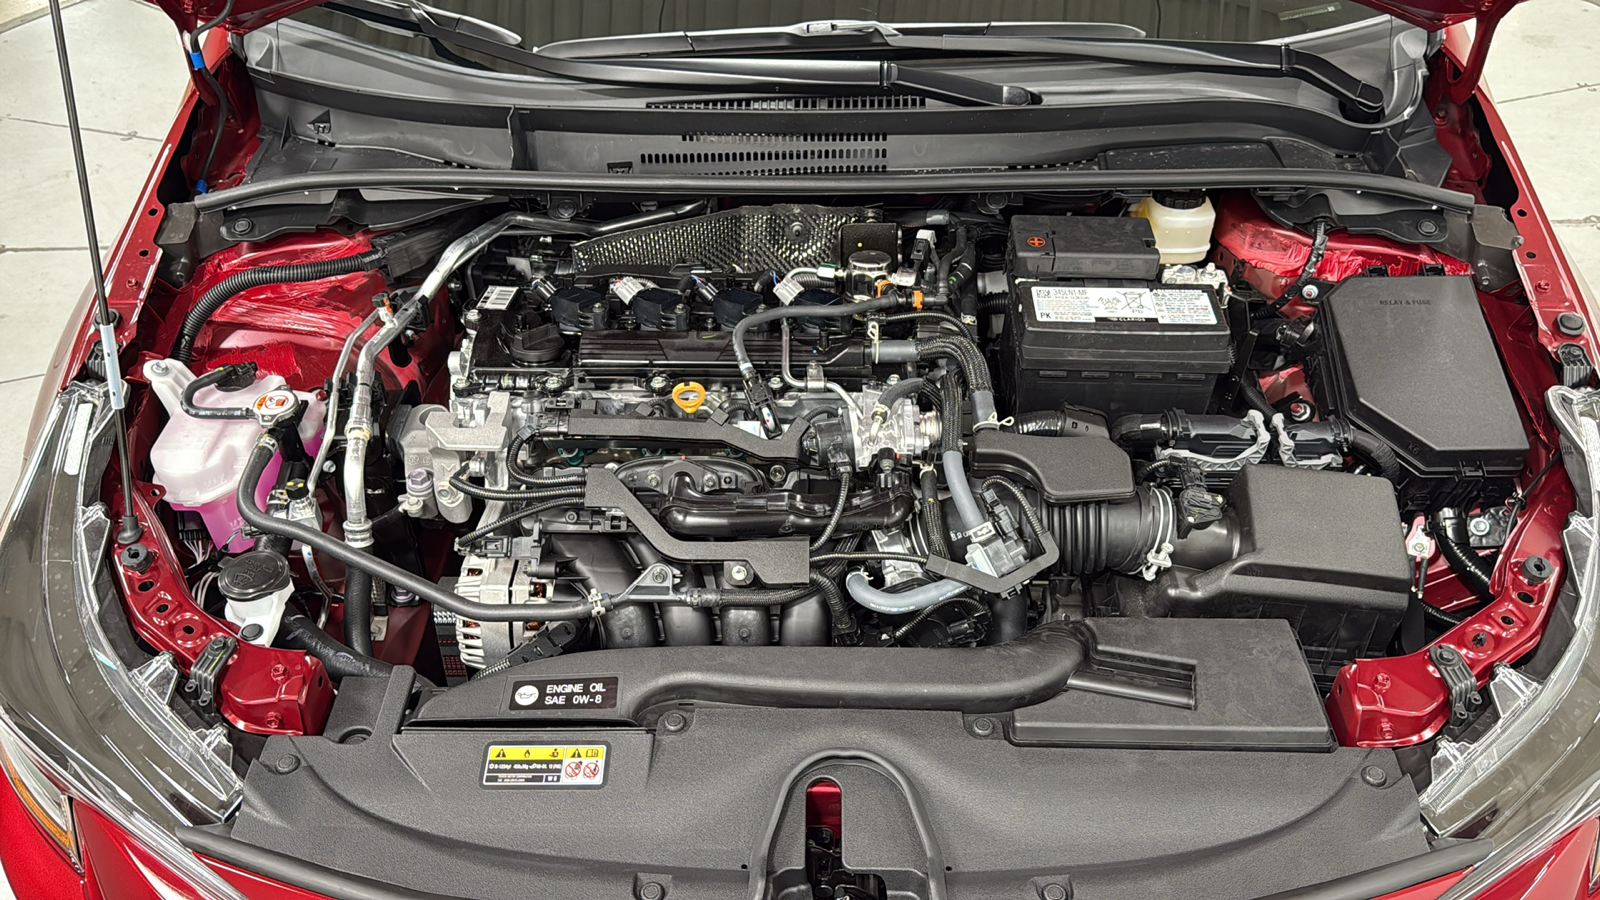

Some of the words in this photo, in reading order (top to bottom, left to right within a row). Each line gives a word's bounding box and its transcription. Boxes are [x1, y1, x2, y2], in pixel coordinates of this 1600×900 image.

[546, 684, 583, 693] ENGINE
[589, 683, 606, 692] OIL
[544, 695, 566, 705] SAE
[572, 694, 602, 704] 0W-8
